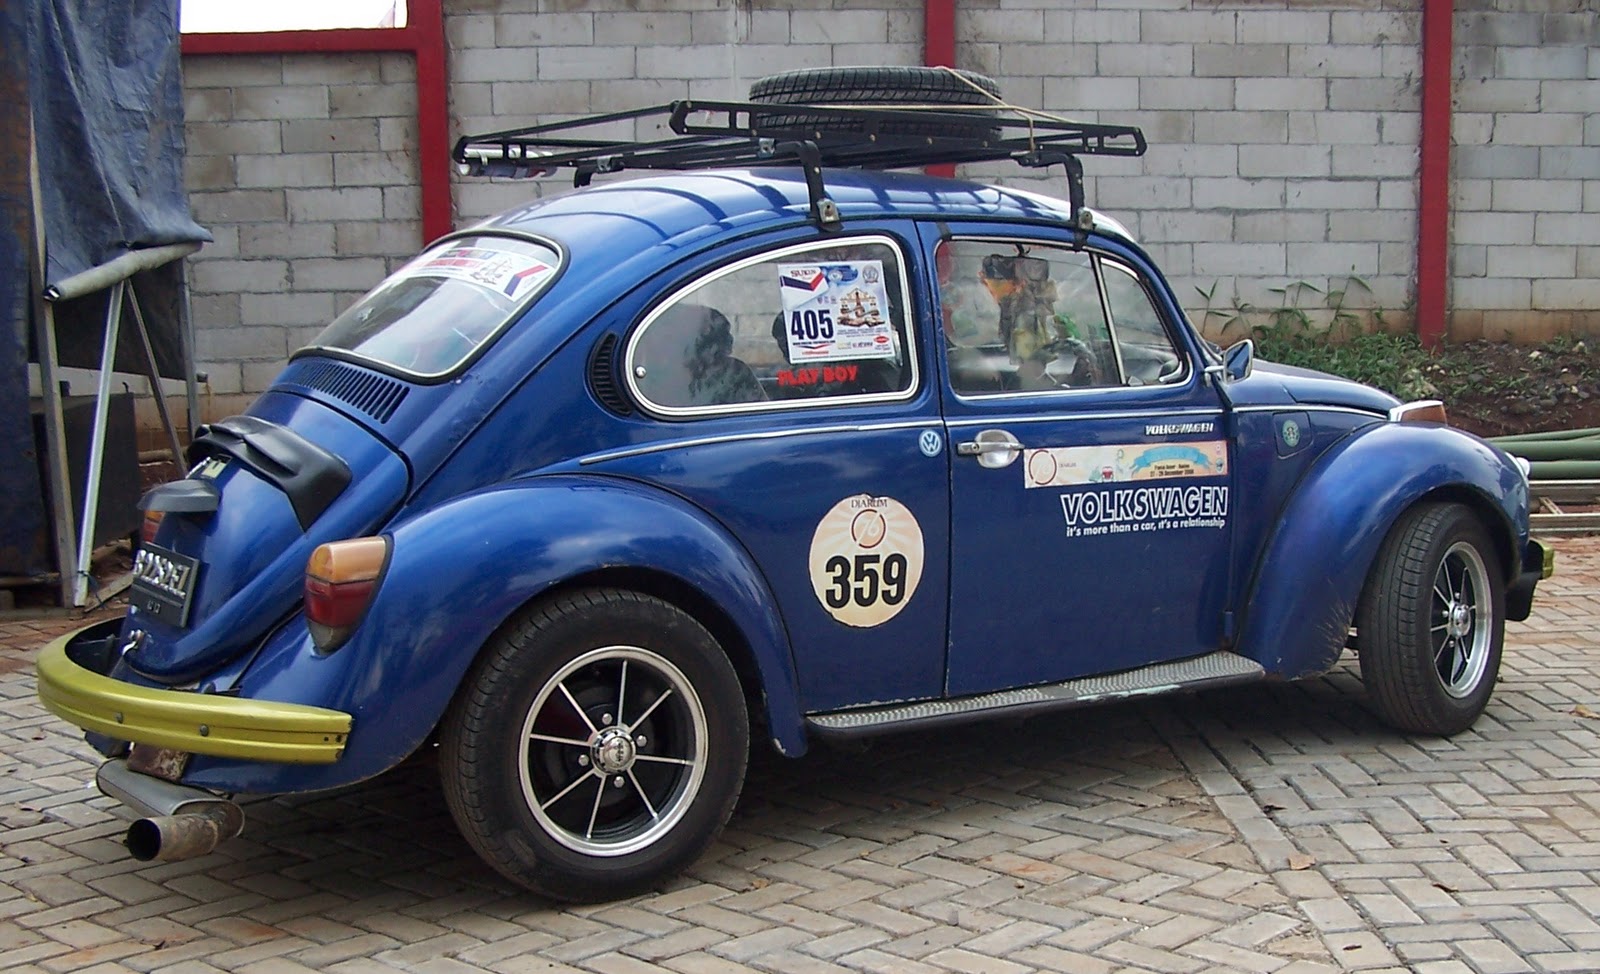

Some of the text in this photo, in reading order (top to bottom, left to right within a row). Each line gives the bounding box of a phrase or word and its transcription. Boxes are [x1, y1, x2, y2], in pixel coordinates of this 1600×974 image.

[791, 309, 834, 340] 405
[776, 365, 858, 386] PLAY BOY
[1060, 486, 1229, 525] VOLKSWAGEN
[1066, 516, 1226, 537] it's more than a car, it's a relationship
[825, 553, 908, 609] 359
